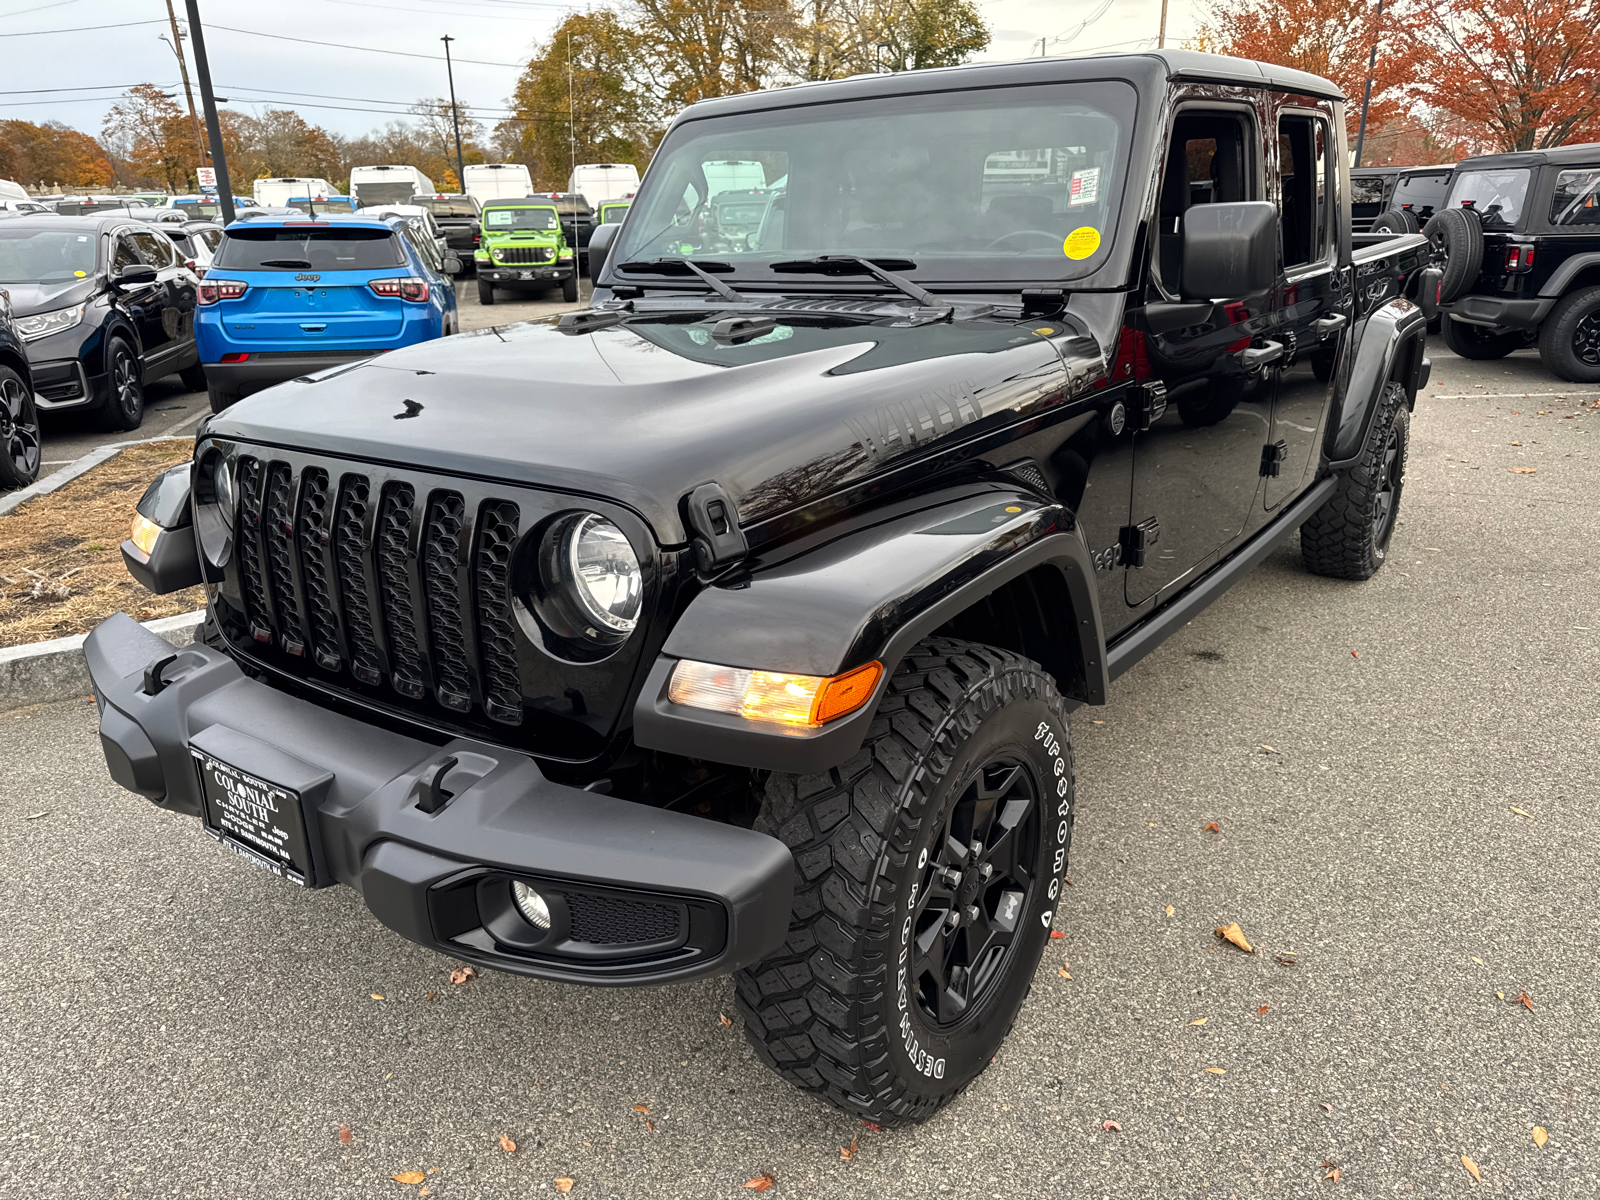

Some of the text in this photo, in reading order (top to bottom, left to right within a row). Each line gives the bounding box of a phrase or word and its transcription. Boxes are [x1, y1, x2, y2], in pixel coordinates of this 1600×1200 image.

[295, 273, 320, 282] Jeep
[842, 378, 983, 459] WILLYS
[1090, 542, 1123, 571] eep
[214, 771, 279, 813] COLONIAL
[227, 790, 270, 823] SOUTH
[215, 799, 289, 840] CHRYSLER Jeep
[223, 810, 283, 846] DODGE RAM
[272, 865, 282, 876] MA
[279, 847, 290, 860] MA
[897, 883, 946, 1080] DESTINATION
